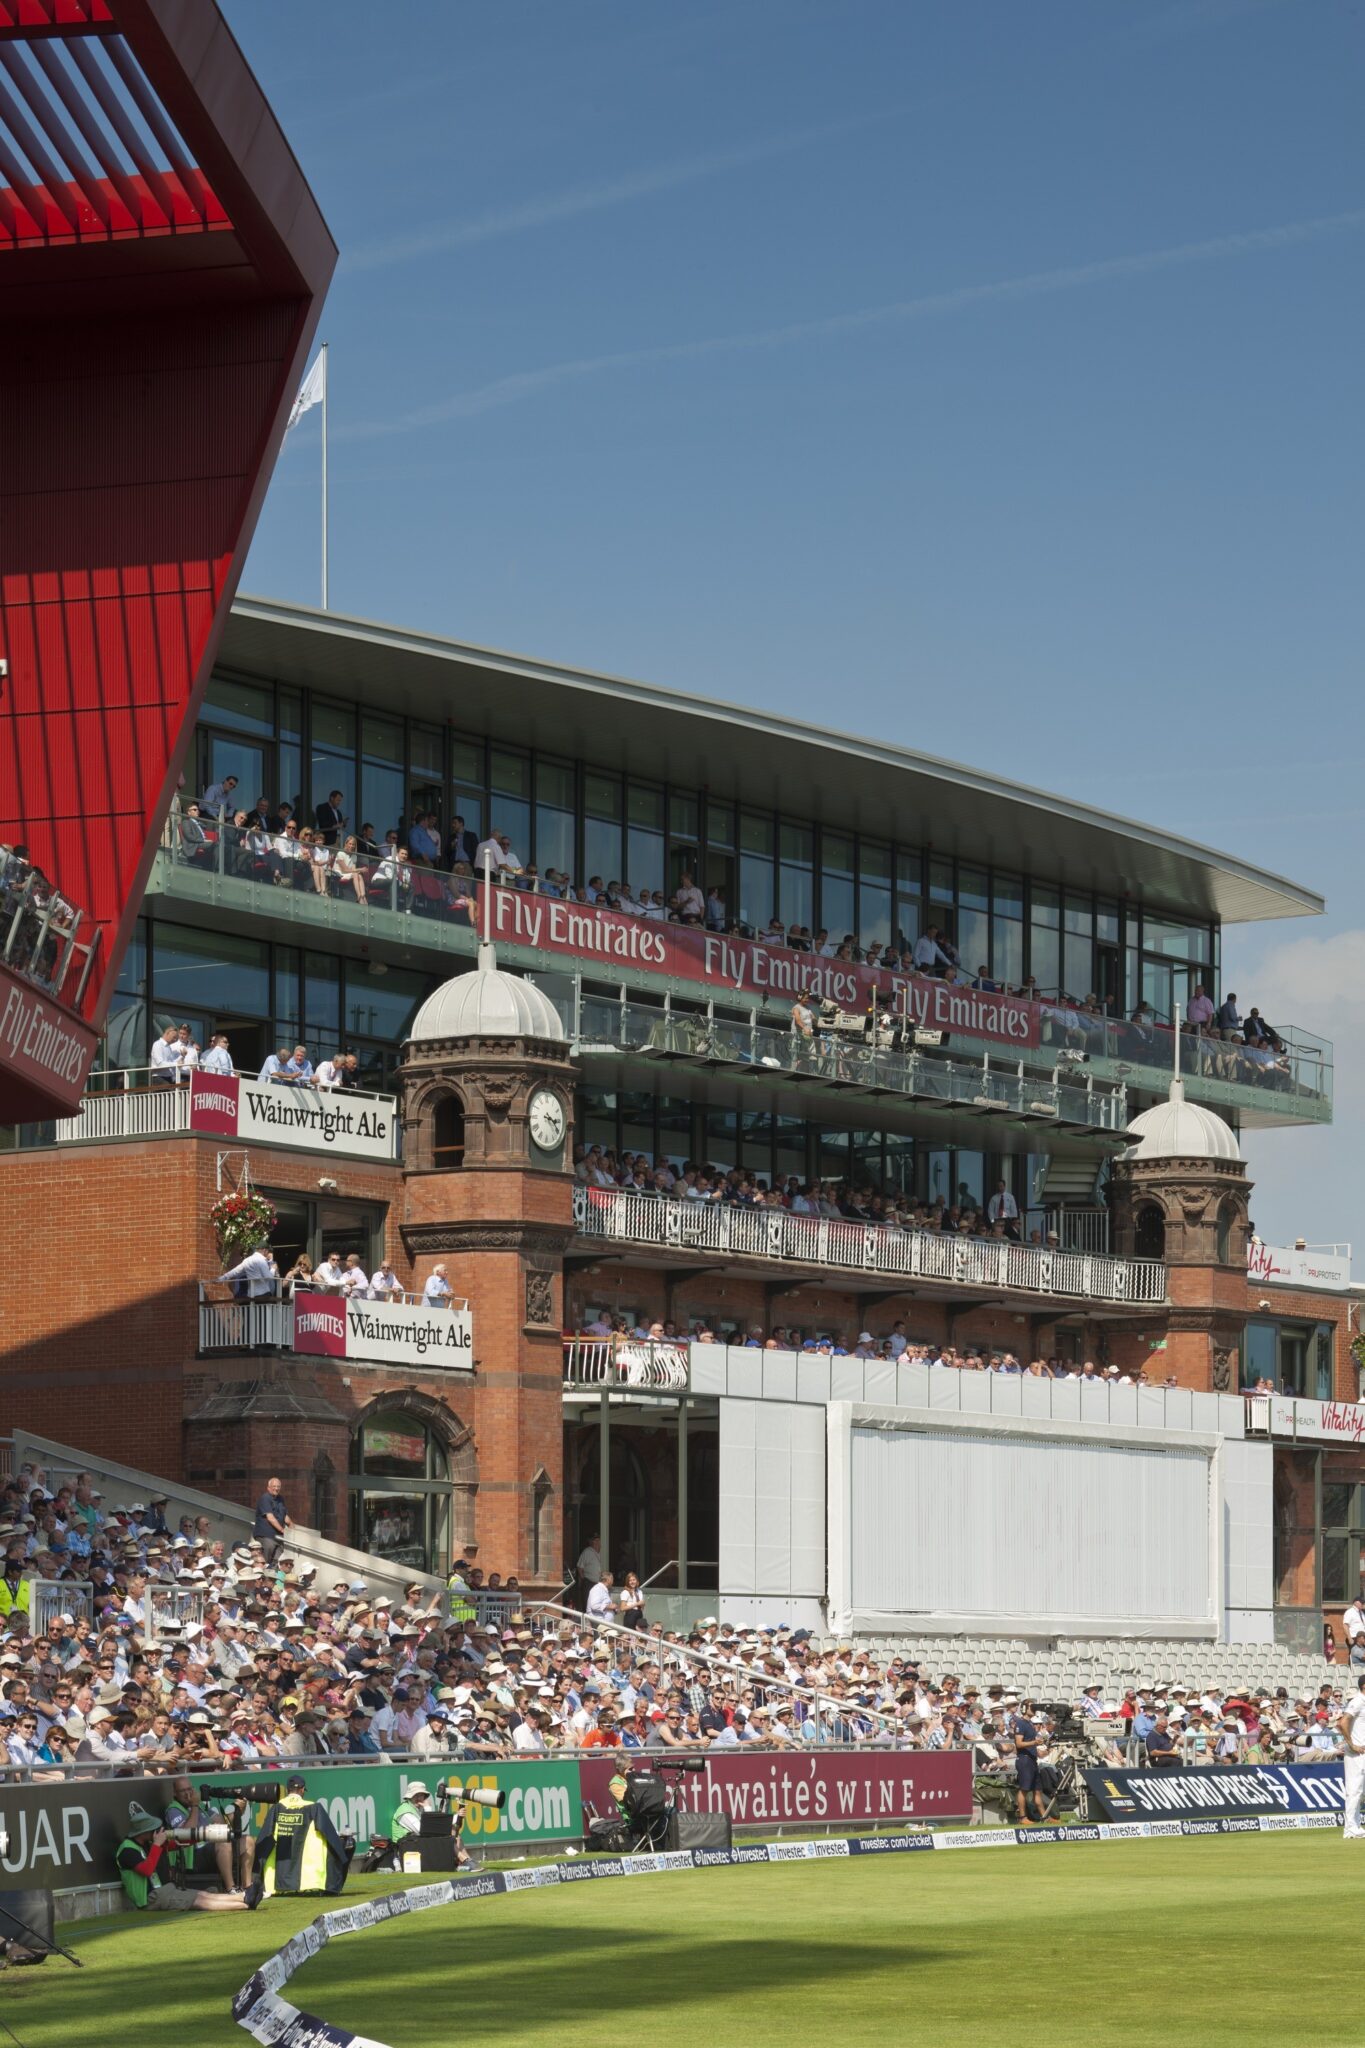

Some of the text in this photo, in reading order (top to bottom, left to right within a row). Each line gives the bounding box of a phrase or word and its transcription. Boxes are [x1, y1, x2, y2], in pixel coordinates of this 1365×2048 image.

[495, 890, 666, 963] Fly Emirates
[704, 937, 857, 1003] Fly Emirates
[891, 977, 1029, 1039] Fly Emirates
[0, 986, 87, 1084] Fly Emirates
[193, 1092, 236, 1117] THWAITES
[246, 1091, 386, 1142] Wainwright Ale
[297, 1312, 344, 1338] THWAITES
[347, 1312, 471, 1353] Wainwright Ale
[1285, 1415, 1316, 1426] PRHEALTH
[1321, 1401, 1365, 1442] Vitality
[837, 1779, 914, 1814] WINE
[1126, 1774, 1274, 1811] STOWFORD PRESS
[1025, 1826, 1098, 1843] Investec Investec
[1108, 1821, 1180, 1837] Investec Investec
[1187, 1818, 1260, 1834] Investec Investec
[1267, 1816, 1298, 1830] Investec
[1307, 1814, 1337, 1827] Investec
[700, 1846, 768, 1866] Investec Investec
[776, 1841, 847, 1860] Investec Investec
[629, 1857, 658, 1873] Investec
